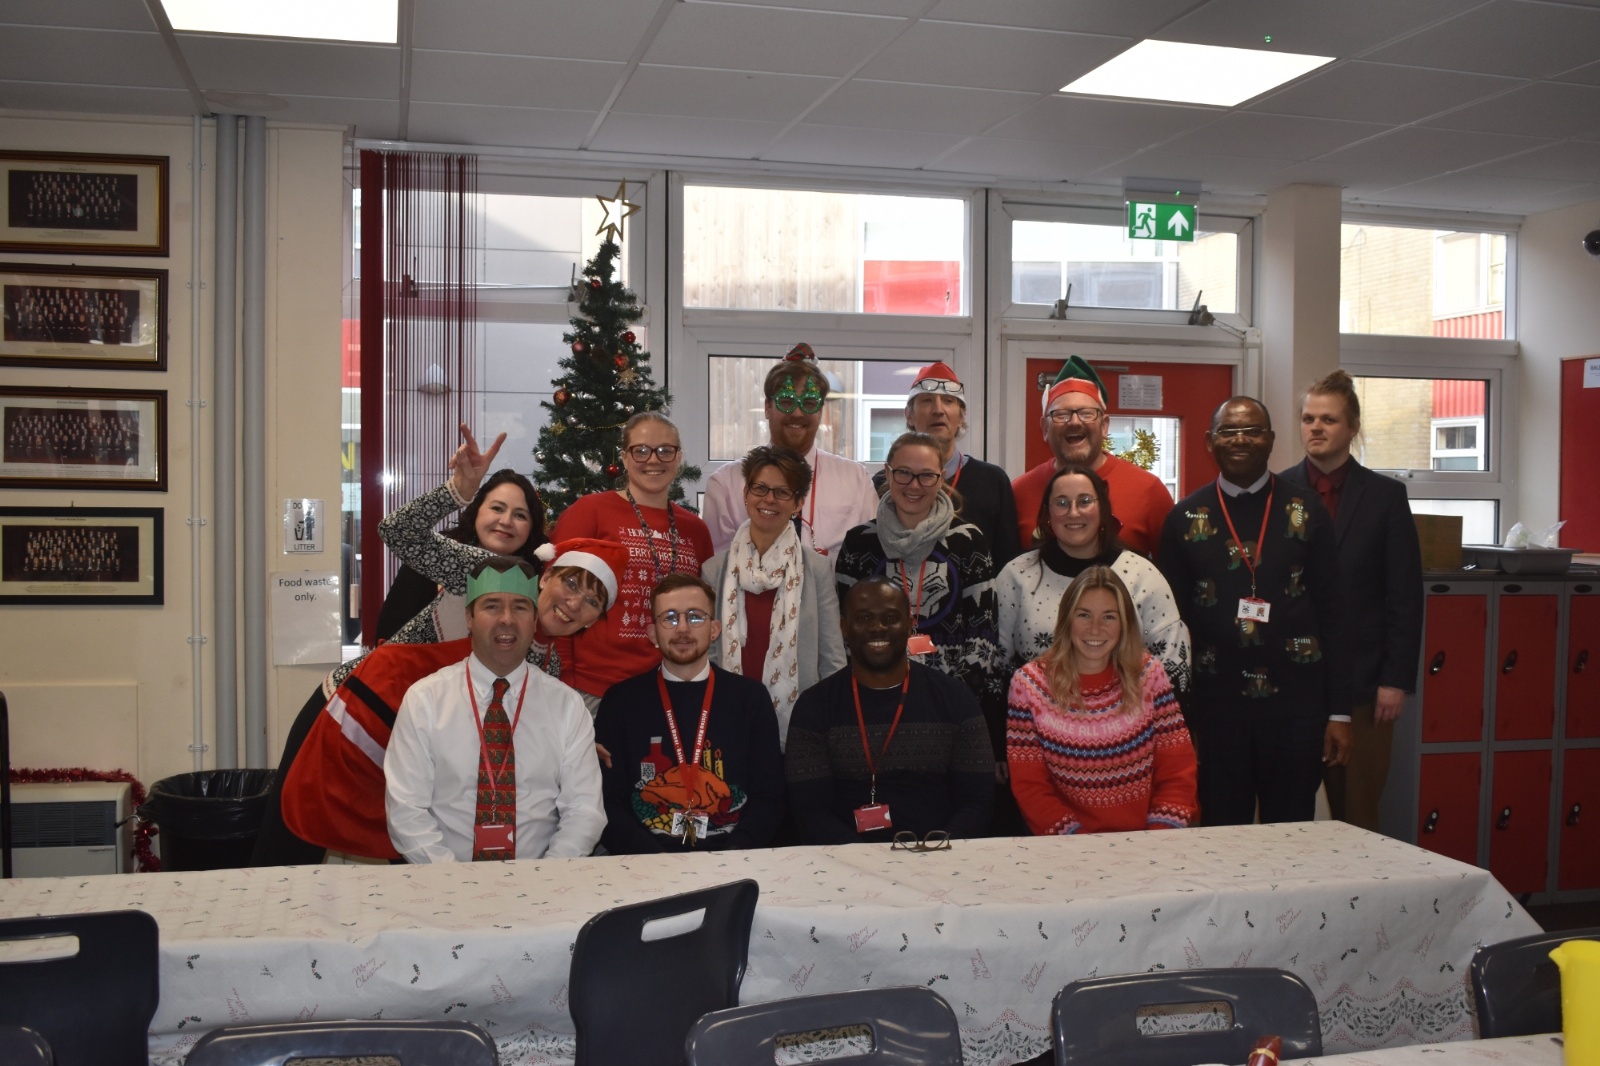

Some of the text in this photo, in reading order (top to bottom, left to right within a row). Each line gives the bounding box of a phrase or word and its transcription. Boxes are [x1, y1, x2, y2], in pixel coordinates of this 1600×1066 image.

[628, 547, 651, 558] ERRY
[279, 577, 302, 588] Food
[294, 591, 317, 603] only.
[352, 957, 376, 976] Merry
